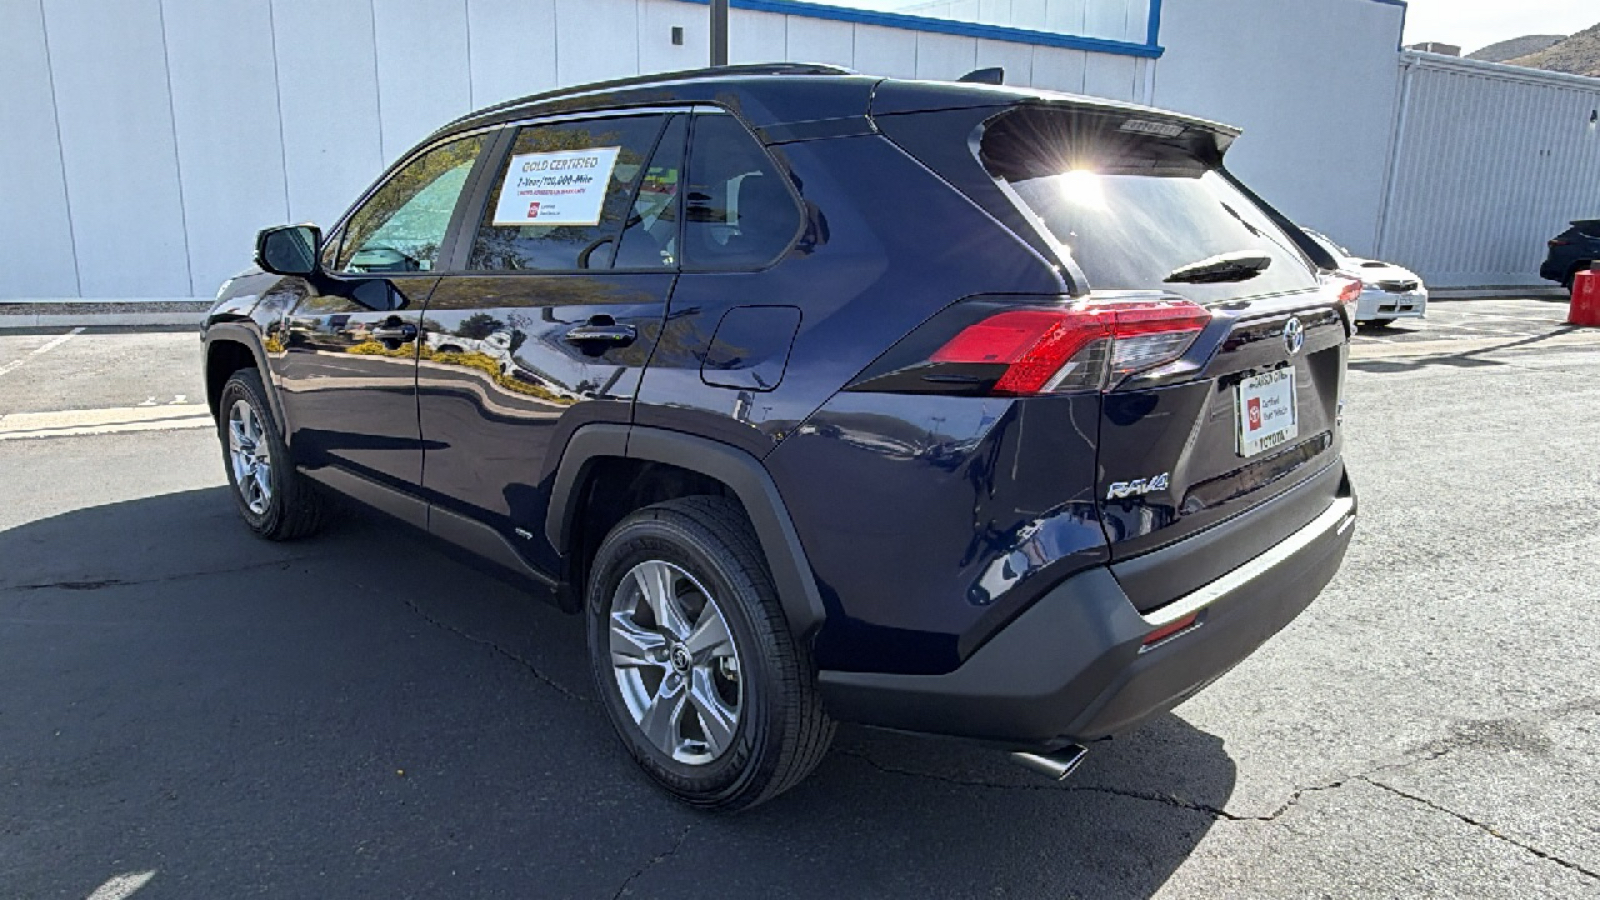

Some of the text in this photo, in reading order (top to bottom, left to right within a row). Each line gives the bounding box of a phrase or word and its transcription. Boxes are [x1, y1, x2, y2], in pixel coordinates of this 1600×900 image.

[522, 157, 599, 173] GOLD CERTIFIED
[1259, 429, 1285, 450] TOYOTA
[1106, 472, 1169, 499] RAV4
